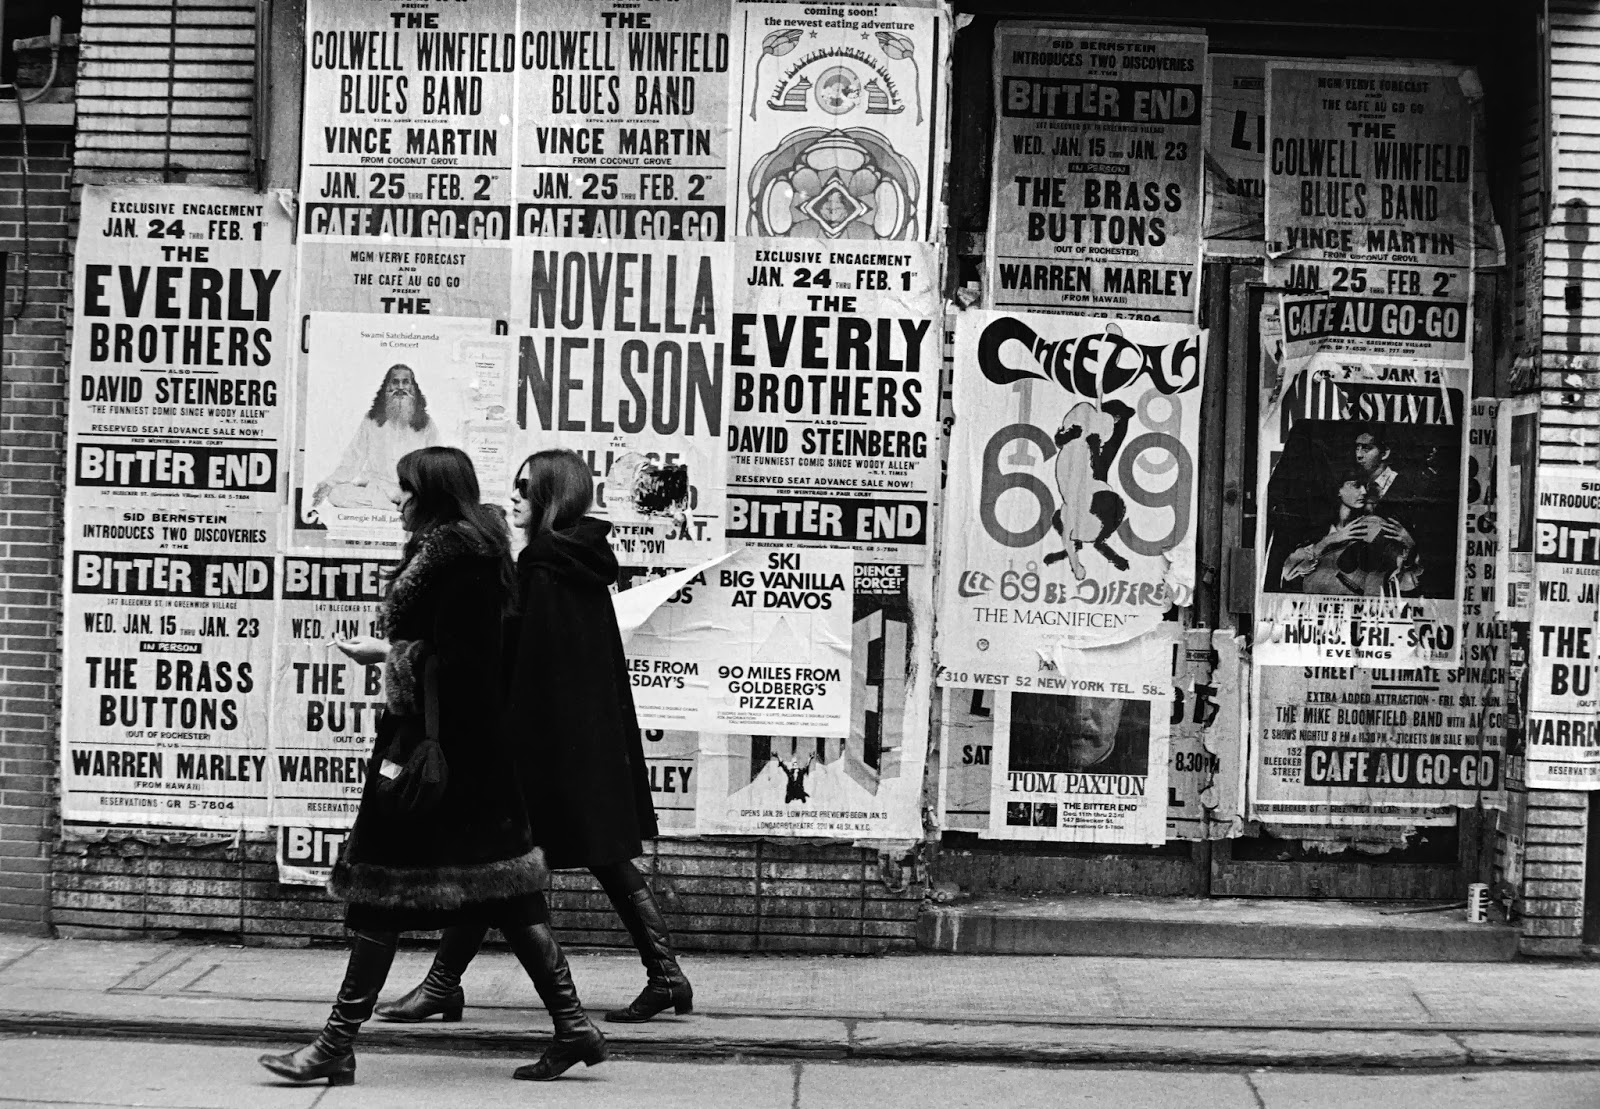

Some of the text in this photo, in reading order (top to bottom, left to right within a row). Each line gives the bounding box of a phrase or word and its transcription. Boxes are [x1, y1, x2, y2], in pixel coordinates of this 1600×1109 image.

[391, 13, 439, 29] THE
[765, 17, 781, 25] the
[825, 19, 858, 30] eating
[861, 20, 914, 30] adventure
[804, 7, 877, 17] coming soon!
[312, 31, 515, 72] COLWELL WINFIELD
[522, 31, 728, 72] COLWELL WINFIELD
[340, 75, 482, 115] BLUES BAND
[1008, 80, 1195, 121] BITTER END
[325, 127, 496, 156] VINCE MARTIN
[537, 127, 710, 155] VINCE MARTIN
[1272, 138, 1471, 183] COLWELL WINFIELD
[1015, 175, 1181, 212] THE BRASS
[1300, 180, 1441, 221] BLUES BAND
[111, 202, 263, 216] EXCLUSIVE ENGAGEMENT
[311, 206, 504, 239] CAFE AU GO-GO
[103, 218, 138, 237] JAN.
[148, 219, 185, 239] 24
[209, 220, 243, 240] FEB.
[1028, 210, 1166, 246] BUTTONS
[161, 246, 209, 262] THE
[351, 251, 465, 265] MGM VERVE FORECAST
[84, 264, 281, 321] EVERLY
[354, 274, 459, 287] THE CAFE AU GO GO
[530, 250, 715, 335] NOVELLA
[1000, 264, 1192, 296] WARREN MARLEY
[381, 298, 430, 314] THE
[807, 295, 856, 312] THE
[1289, 302, 1459, 338] CAFE AU GO-GO
[90, 323, 271, 366] BROTHERS
[386, 332, 439, 340] Satchidananda
[731, 313, 931, 372] EVERLY
[978, 314, 1200, 398] CHEETAH
[81, 375, 276, 406] DAVID STEINBERG
[517, 336, 724, 437] NELSON
[734, 372, 921, 418] BROTHERS
[110, 406, 149, 414] FUNNIEST
[153, 407, 176, 415] COMIC
[181, 408, 203, 416] SINCE
[208, 409, 236, 417] WOODY
[728, 425, 926, 458] DAVID STEINBERG
[81, 447, 271, 488] BITTER END
[124, 513, 226, 523] SID BERNSTEIN
[726, 498, 921, 540] BITTER END
[84, 525, 266, 543] INTRODUCES TWO DISCOVERIES
[78, 555, 268, 596] BITTER END
[769, 553, 800, 570] SKI
[720, 570, 845, 591] BIG VANILLA
[732, 591, 831, 610] AT DAVOS
[85, 613, 116, 633] WED.
[123, 614, 152, 634] JAN.
[161, 616, 176, 635] 15
[199, 617, 229, 637] JAN.
[237, 618, 259, 638] 23
[159, 643, 197, 651] PERSON
[1540, 626, 1592, 659] THE
[86, 657, 253, 693] THE BRASS
[719, 666, 840, 681] 90 MILES FROM
[945, 672, 1134, 693] 310 WEST 52 NEW YORK TEL.
[1447, 665, 1508, 687] SPINACH
[729, 681, 826, 696] GOLDBERG'S
[1306, 692, 1429, 705] EXTRA ADDED ATTRACTION
[100, 695, 238, 730] BUTTONS
[740, 697, 813, 710] PIZZERIA
[1277, 705, 1442, 729] THE MIKE BLOOMFIELD BAND
[161, 732, 210, 740] ROCHESTER)
[72, 750, 266, 782] WARREN MARLEY
[1311, 751, 1493, 786] CAFE AU GO-GO
[1008, 772, 1147, 796] TOM PAXTON
[100, 797, 234, 809] RESERVATIONS GR 5-7804
